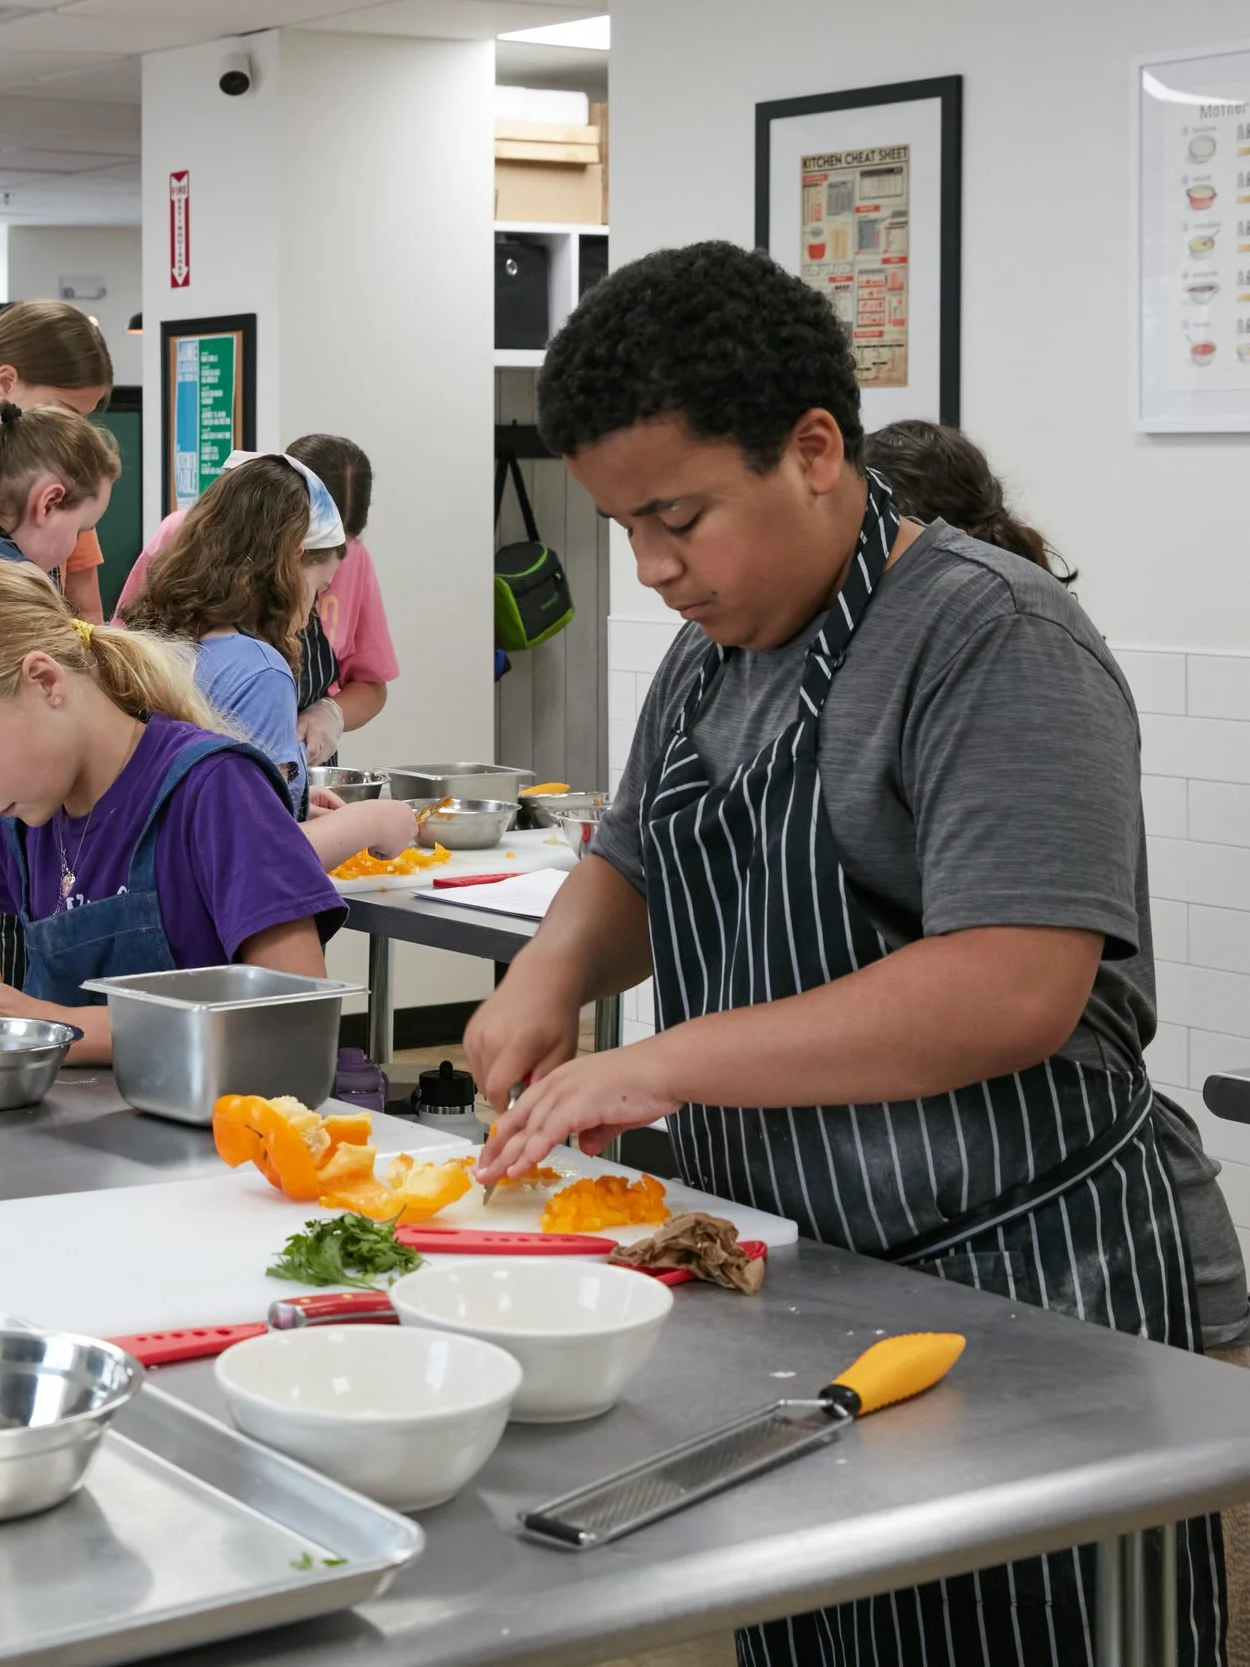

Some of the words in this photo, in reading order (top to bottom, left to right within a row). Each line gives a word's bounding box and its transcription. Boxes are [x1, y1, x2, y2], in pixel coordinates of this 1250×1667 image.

[802, 154, 842, 169] KITCHEN
[844, 151, 875, 165] CHEAT
[878, 146, 908, 161] SHEET
[171, 186, 187, 196] FIRE
